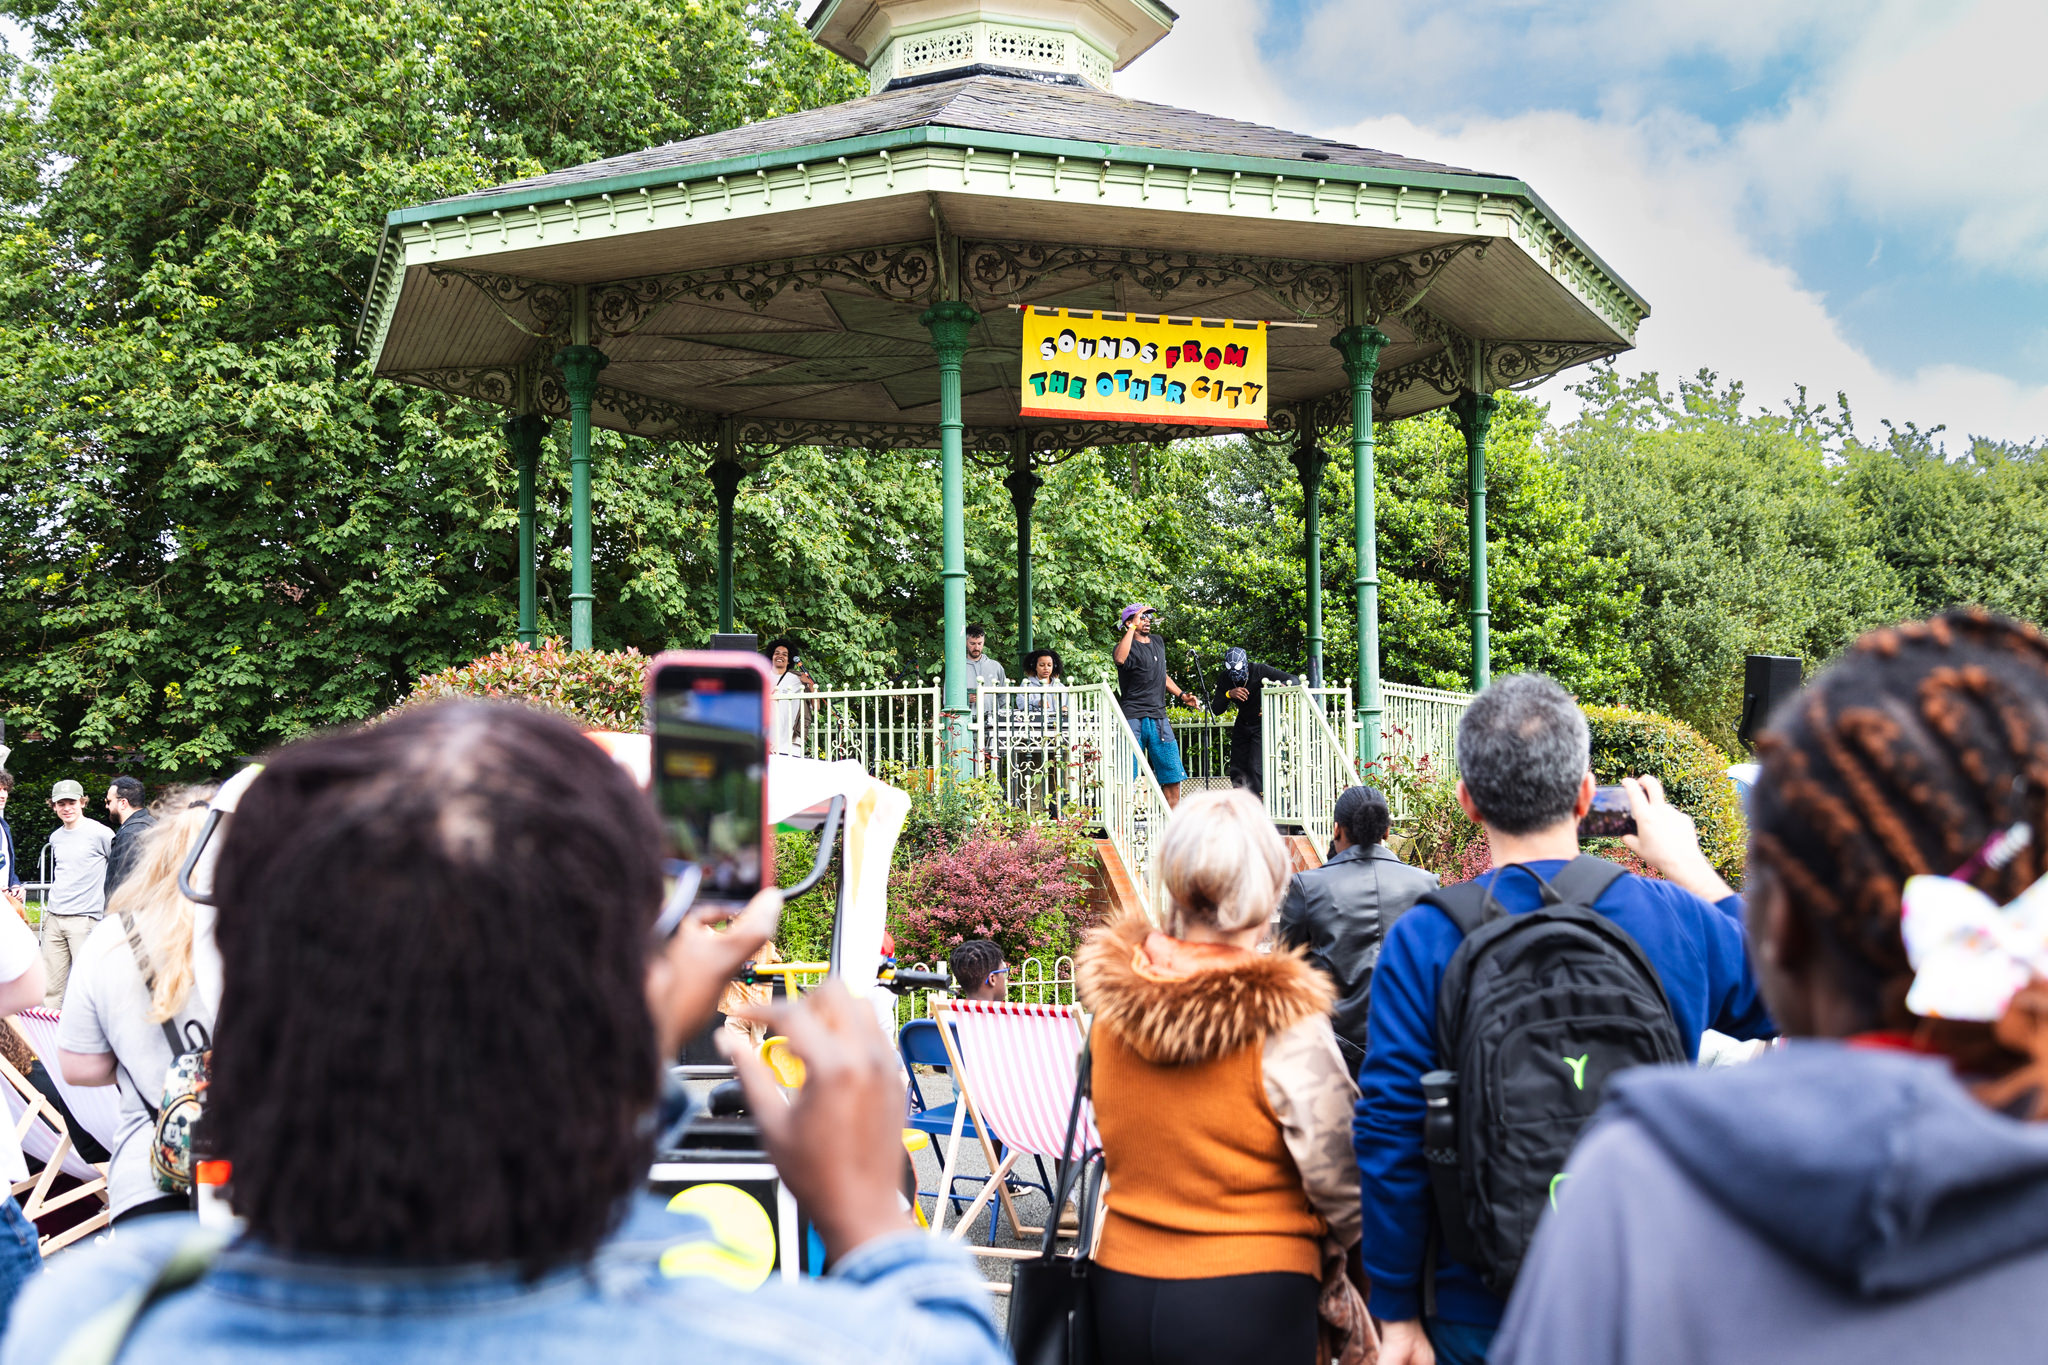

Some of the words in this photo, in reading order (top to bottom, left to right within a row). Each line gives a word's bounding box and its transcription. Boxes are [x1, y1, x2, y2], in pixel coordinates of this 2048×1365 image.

[1039, 328, 1159, 364] SOUNDS
[1165, 340, 1249, 370] FROM
[1029, 370, 1087, 400] THE
[1096, 369, 1186, 404] OTHER
[1191, 375, 1263, 409] CITY
